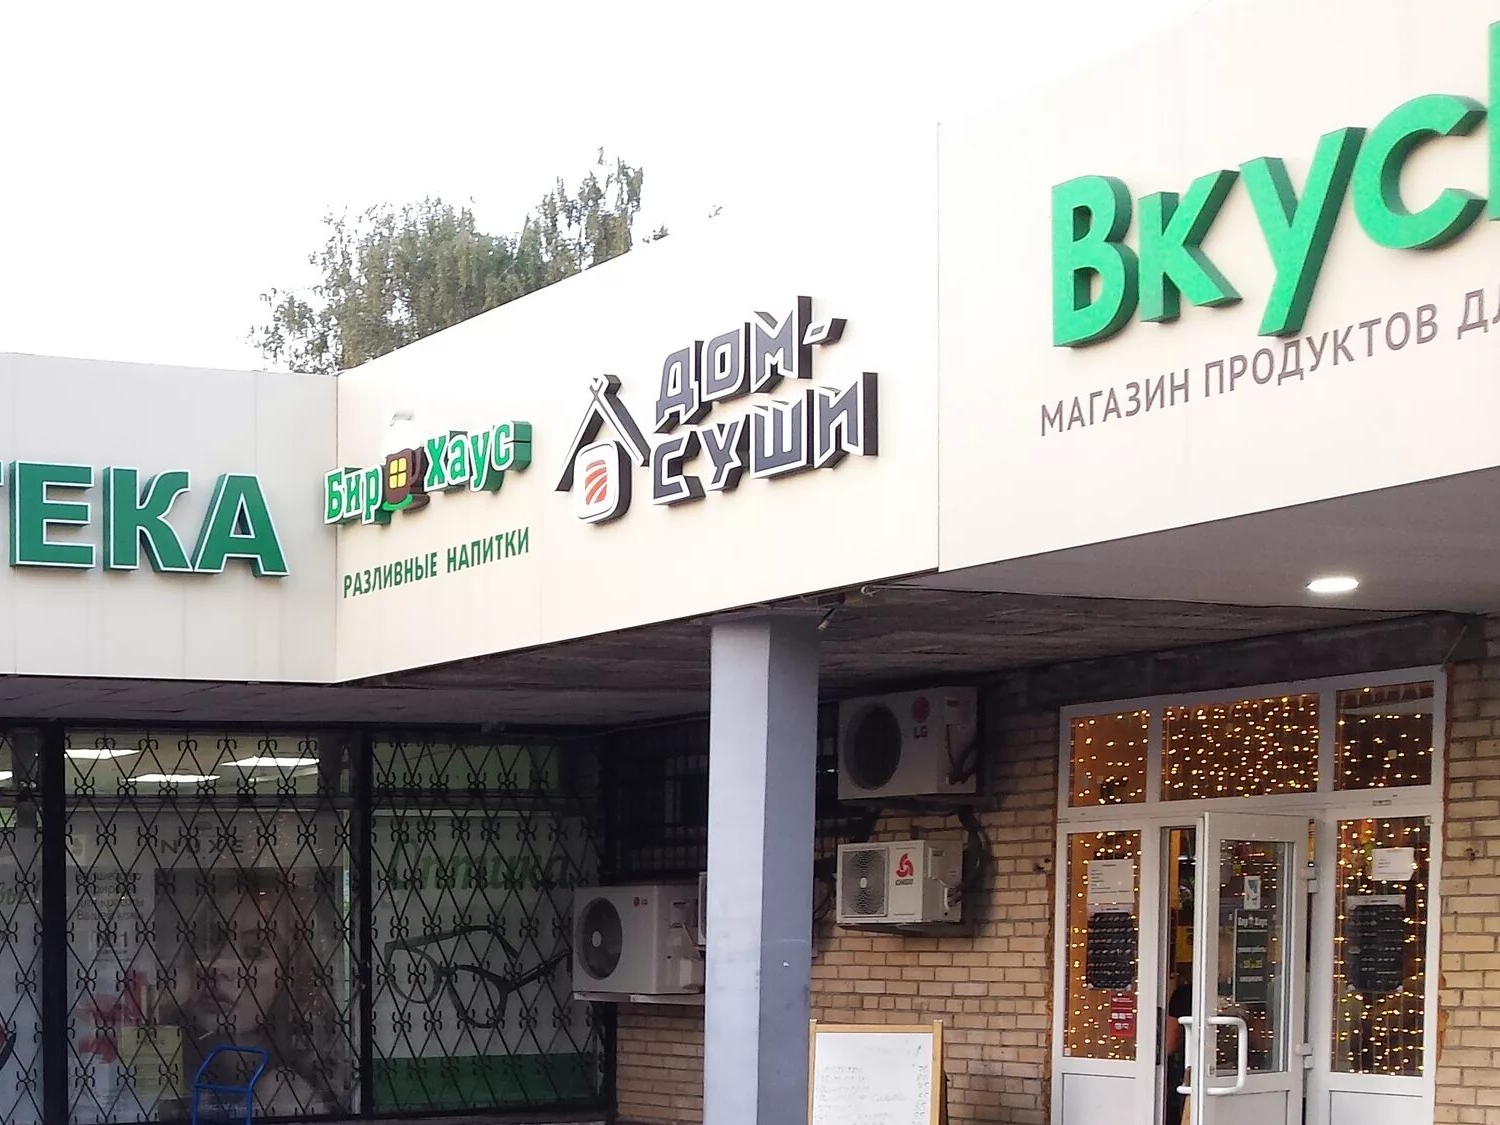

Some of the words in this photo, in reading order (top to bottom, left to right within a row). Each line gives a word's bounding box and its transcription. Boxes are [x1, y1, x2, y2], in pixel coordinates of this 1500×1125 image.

[1051, 22, 1500, 349] Вкус
[654, 295, 848, 433] ДОМ-
[1041, 367, 1190, 437] МАГАЗИН
[1204, 304, 1438, 398] ПРОДУКТОВ
[1456, 283, 1500, 341] Д
[323, 458, 392, 525] Бир
[422, 420, 534, 493] Хаус
[652, 371, 879, 506] СУШИ
[342, 551, 439, 599] РАЗЛИВНЫЕ
[445, 526, 530, 572] НАПИТКИ
[913, 725, 928, 739] LG
[160, 839, 245, 854] NUXE
